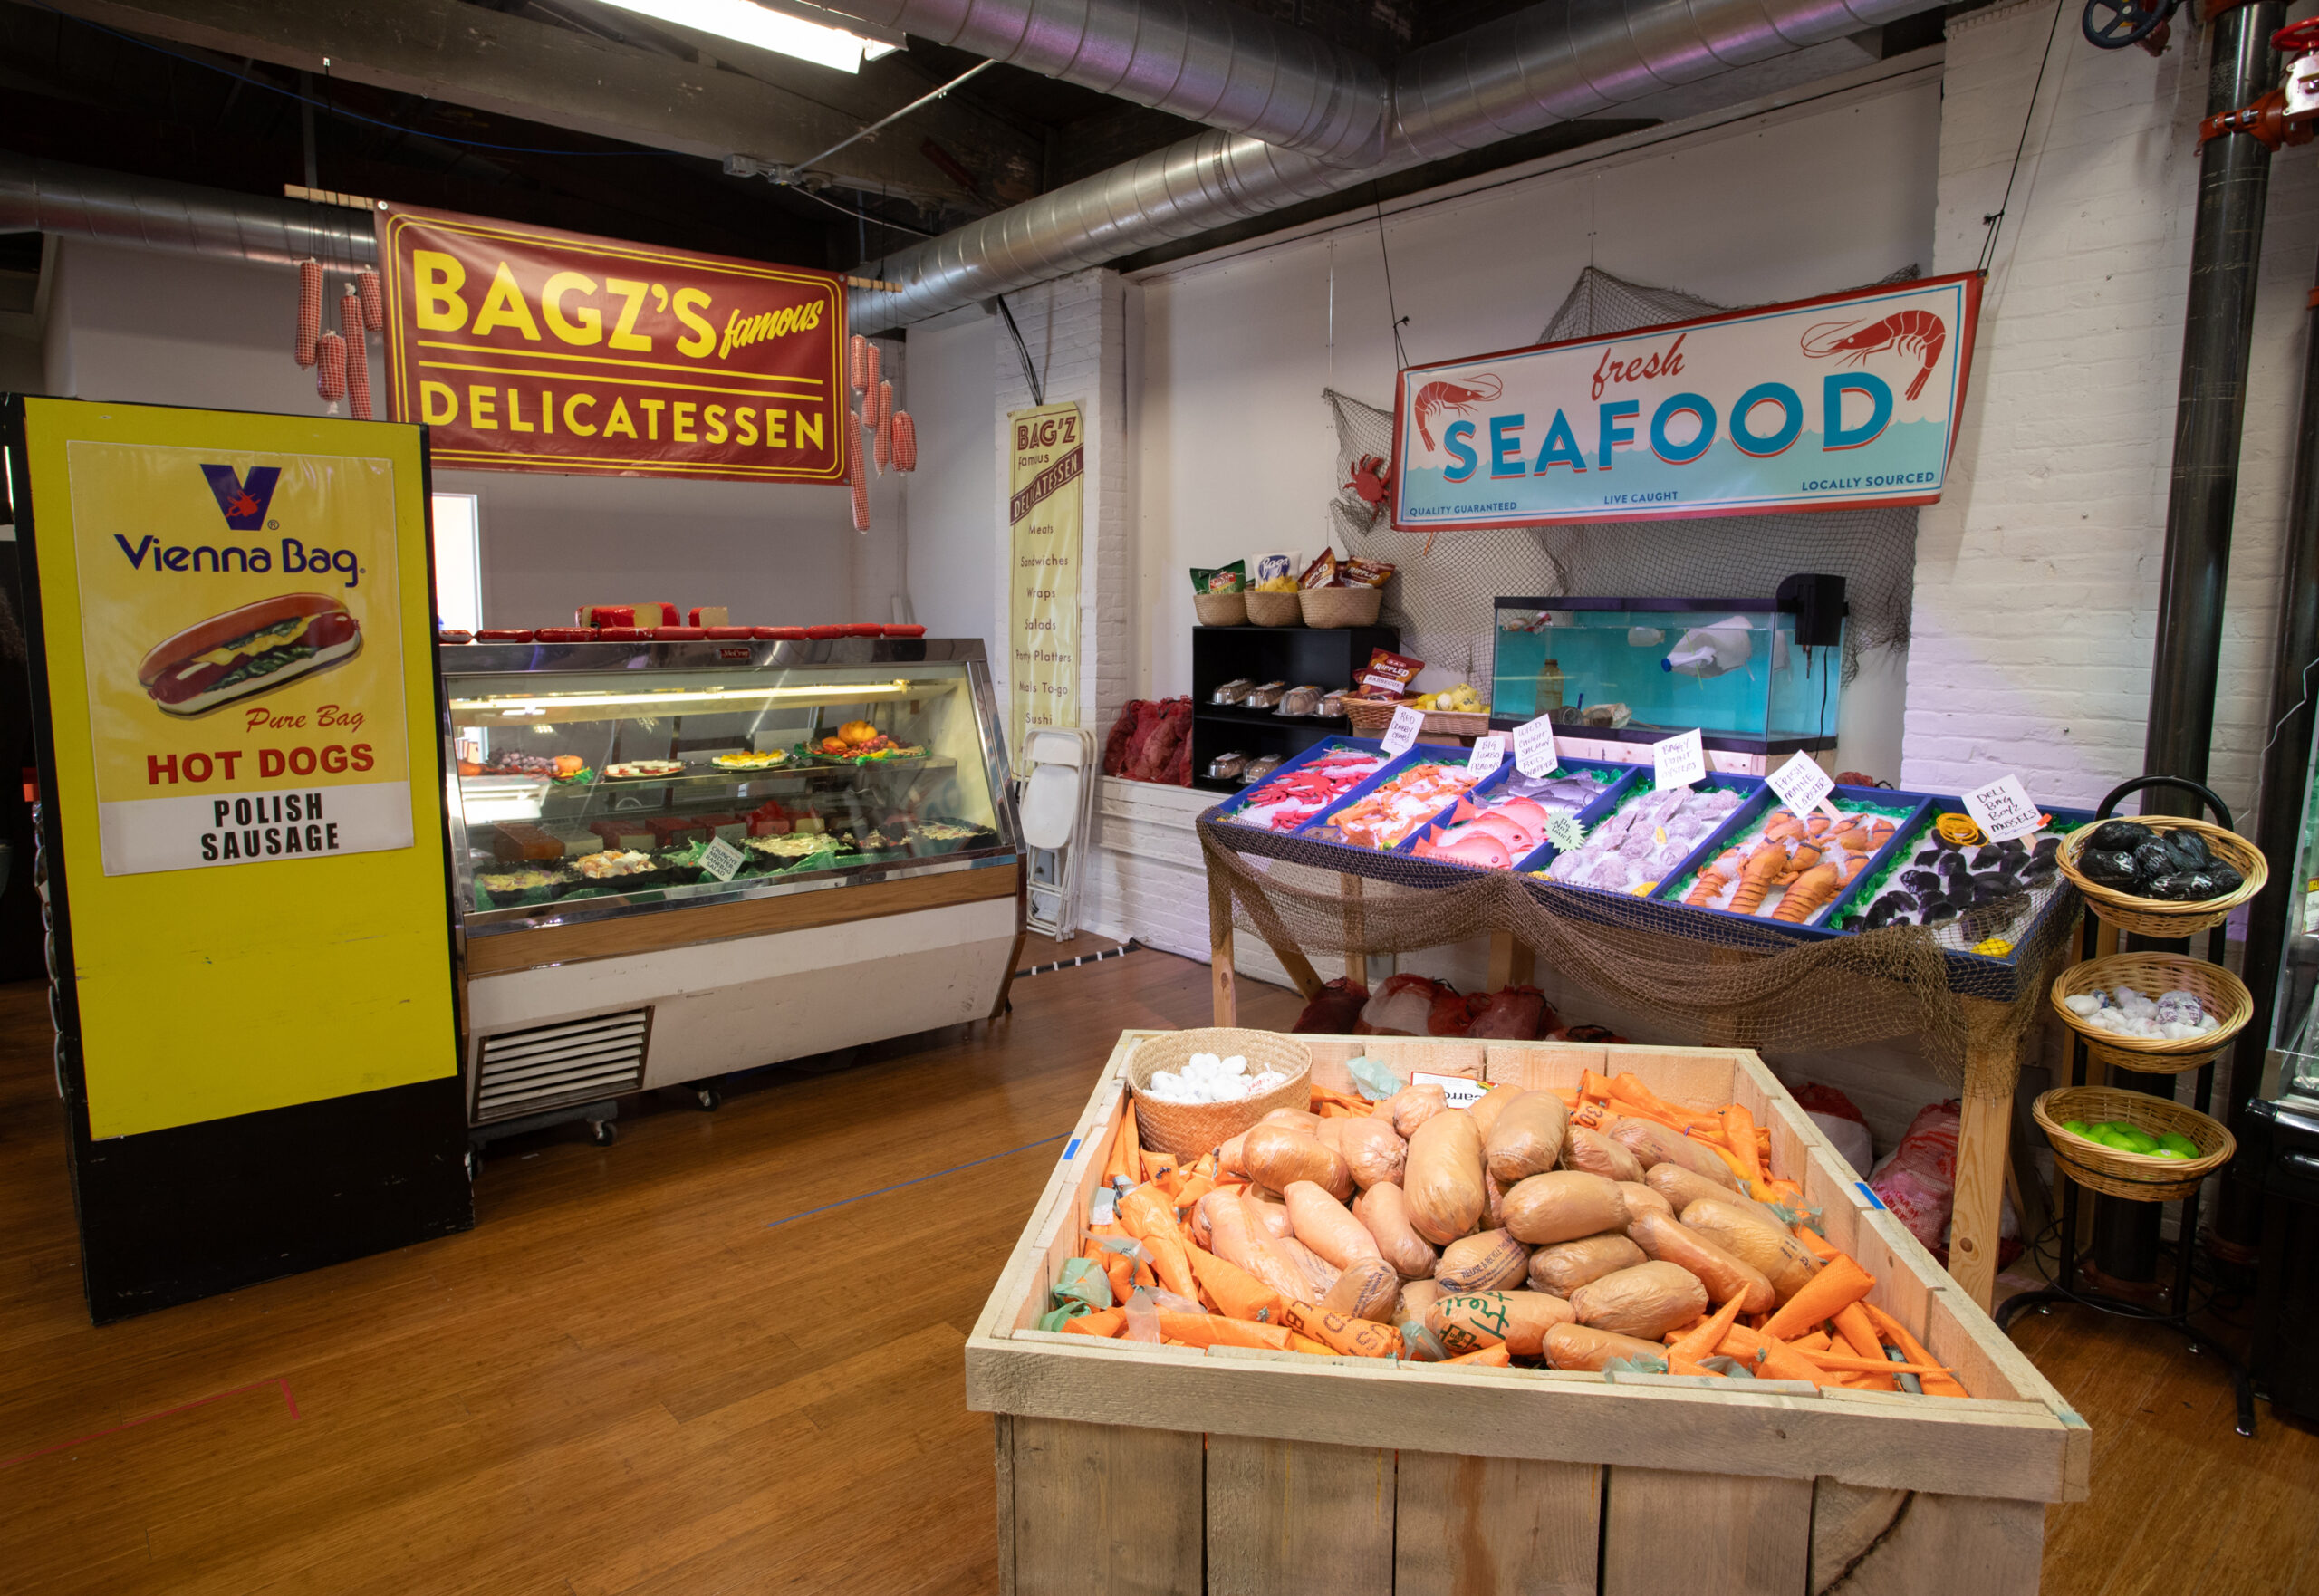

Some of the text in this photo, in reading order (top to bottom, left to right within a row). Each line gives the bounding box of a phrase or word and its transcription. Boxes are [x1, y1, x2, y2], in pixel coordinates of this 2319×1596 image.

[413, 249, 824, 360] BAGZ'S famous
[1592, 333, 1686, 401] fresh
[420, 380, 823, 451] DELICATESSEN
[1017, 416, 1076, 451] BAG'Z
[1443, 372, 1893, 483] SEAFOOD
[1018, 453, 1049, 471] famous
[1014, 454, 1077, 518] DELICATESSEN
[1802, 471, 1935, 491] LOCALLY SOURCED
[1410, 502, 1517, 516] QUALITY GUARANTEED
[1603, 491, 1678, 505] LIVE CAUGHT
[1029, 524, 1054, 534] Meats
[114, 534, 359, 587] Vienna Bag
[1021, 554, 1068, 567] Sandwiches
[1026, 587, 1055, 601] Wraps
[1025, 618, 1056, 630] Salads
[1034, 650, 1072, 663] Platters
[1374, 662, 1410, 678] RIPPLED
[245, 705, 365, 733] Pure Bag
[1025, 712, 1053, 725] Sushi
[147, 743, 375, 785] HOT DOGS
[1775, 763, 1805, 791] FRESH
[1977, 786, 2006, 803] DELI
[215, 792, 323, 828] POLISH
[1991, 809, 2036, 832] MUSSELS
[202, 823, 340, 861] SAUSAGE
